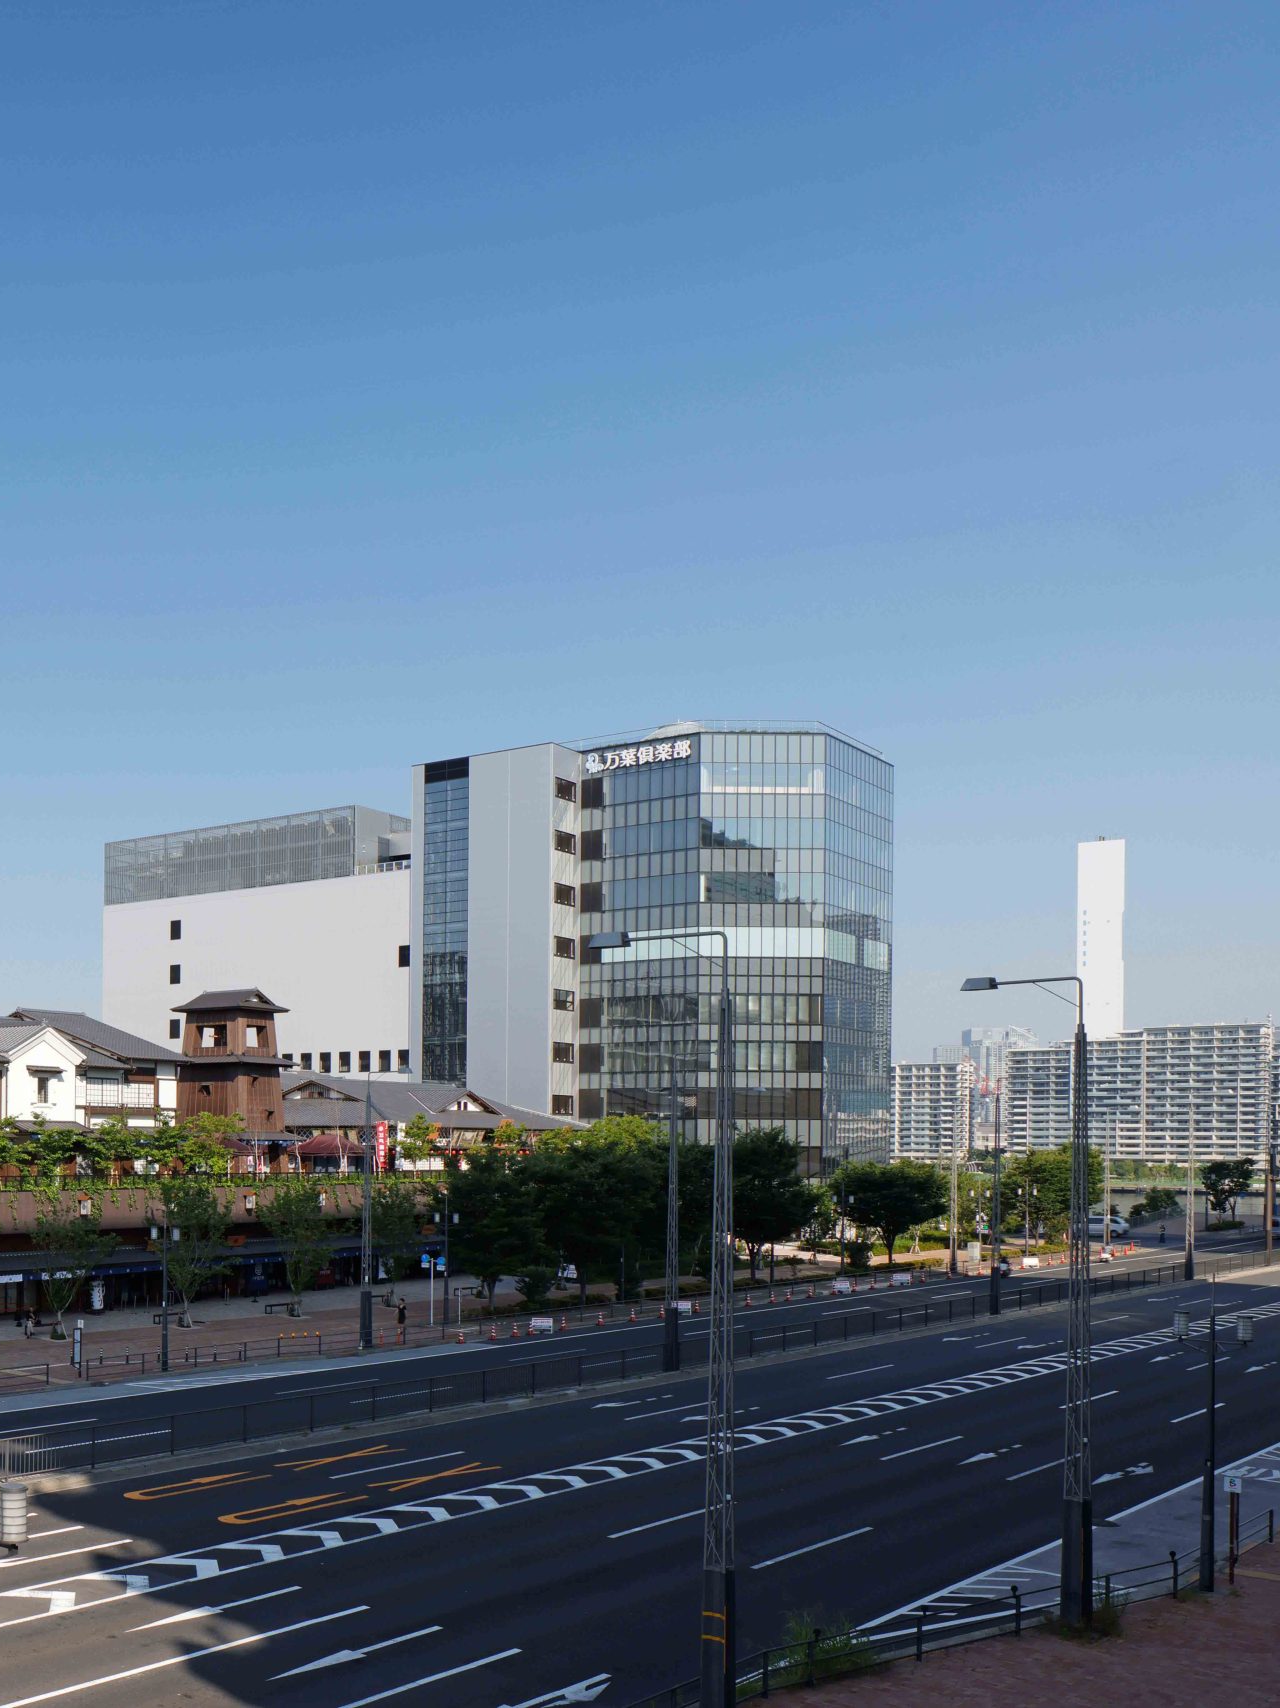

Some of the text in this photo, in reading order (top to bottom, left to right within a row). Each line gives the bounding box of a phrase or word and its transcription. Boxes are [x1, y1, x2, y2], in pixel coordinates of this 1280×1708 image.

[603, 740, 691, 770] 万葉倶楽部
